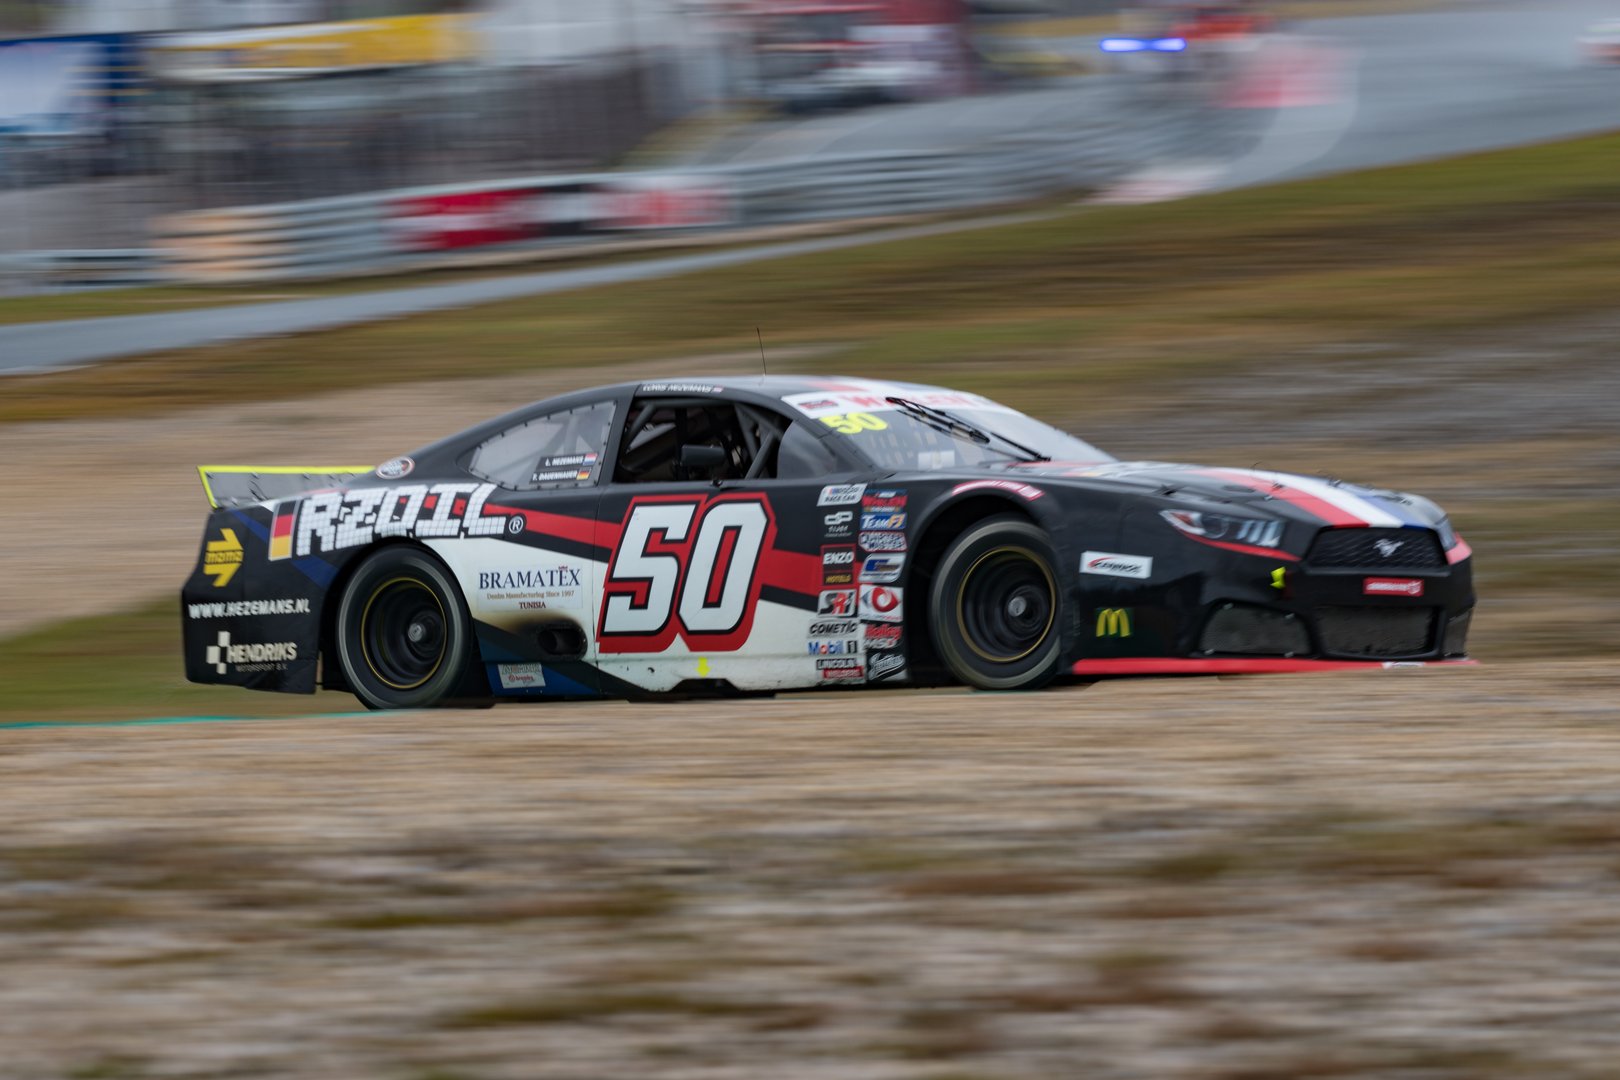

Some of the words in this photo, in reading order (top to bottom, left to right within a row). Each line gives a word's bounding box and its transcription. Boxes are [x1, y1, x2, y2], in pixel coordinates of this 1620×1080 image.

[820, 412, 888, 434] 50
[602, 501, 768, 634] 50
[823, 551, 854, 565] ENZO
[479, 568, 581, 589] BRAMATEX
[188, 599, 311, 619] WWW.HEZEMANS.NL
[809, 620, 858, 634] COMETIC
[227, 642, 298, 663] HENDRIKS
[808, 640, 843, 655] Mobil
